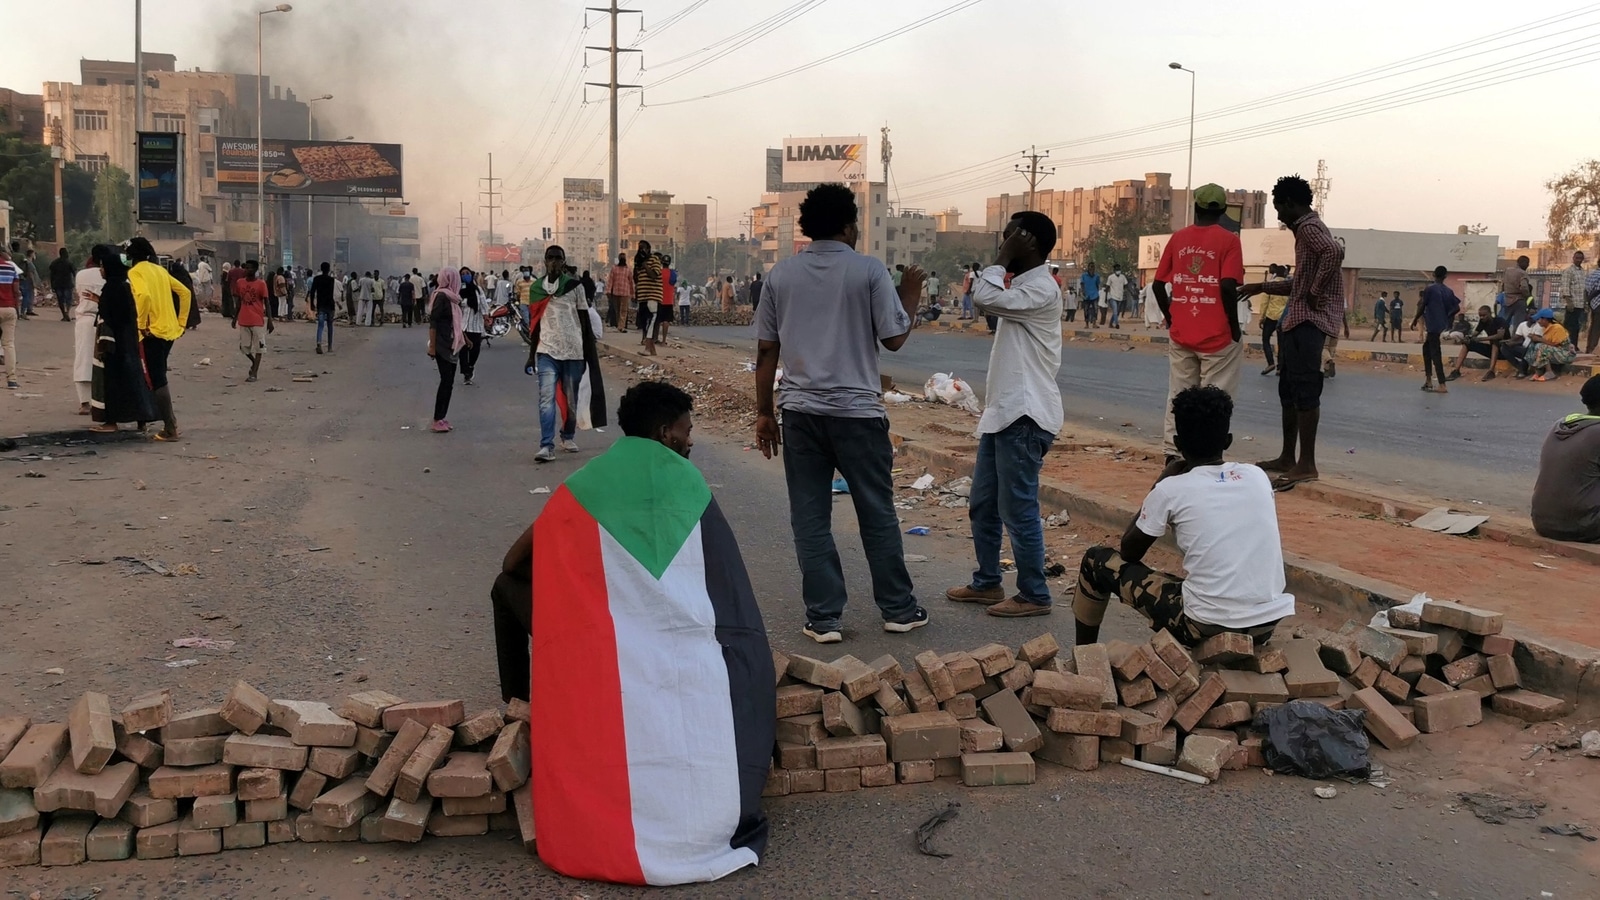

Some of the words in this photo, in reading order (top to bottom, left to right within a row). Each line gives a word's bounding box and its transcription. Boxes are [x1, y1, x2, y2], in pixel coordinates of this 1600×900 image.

[222, 143, 258, 151] AWESOME
[787, 144, 848, 161] LIMAK
[1198, 274, 1218, 284] FedEx
